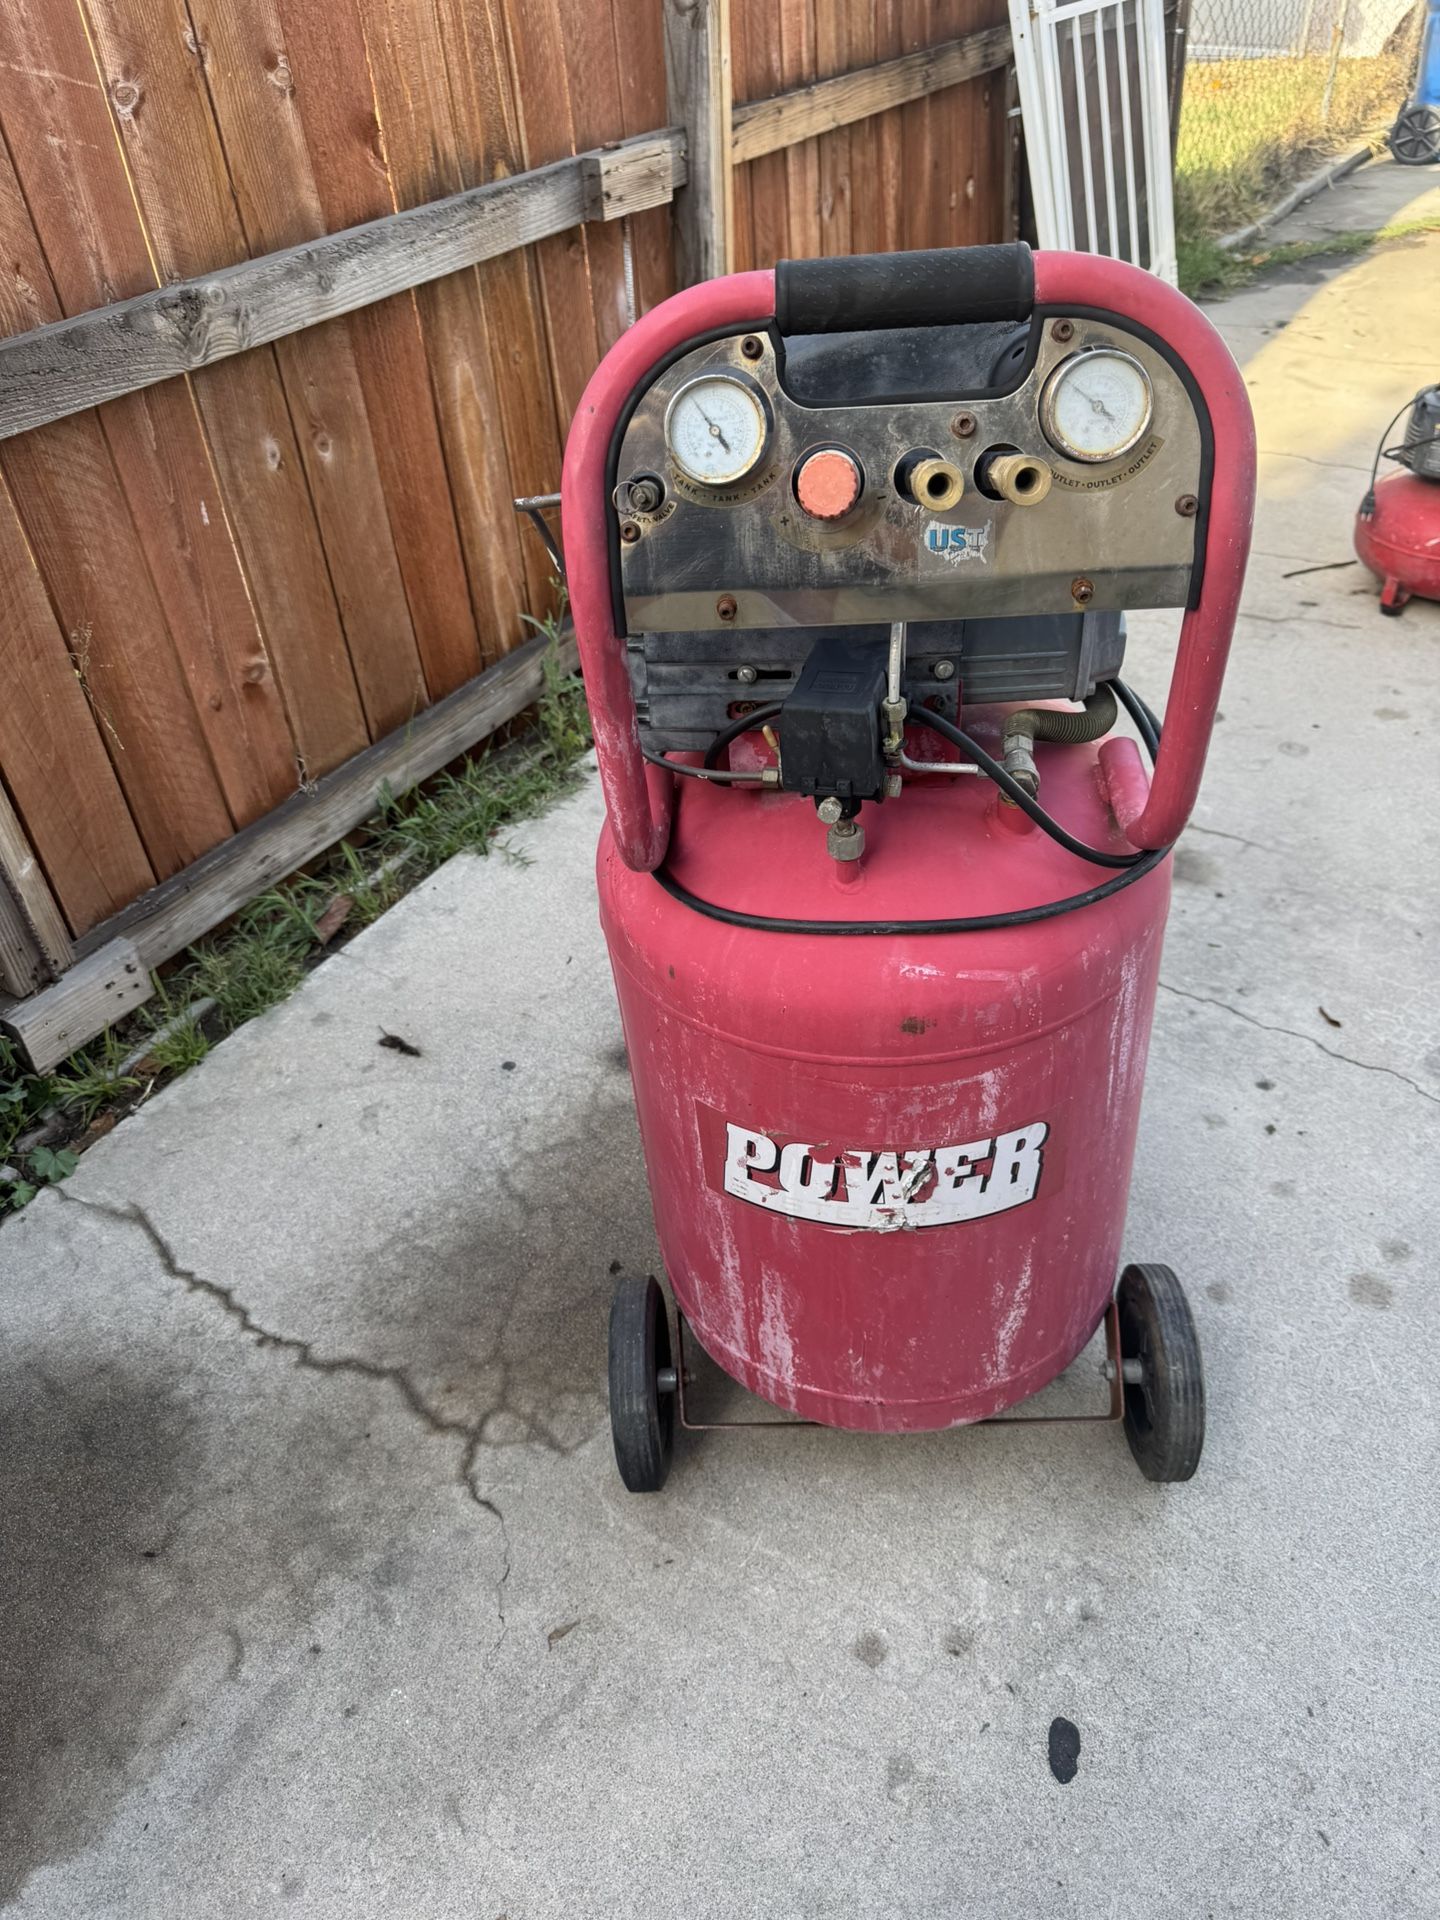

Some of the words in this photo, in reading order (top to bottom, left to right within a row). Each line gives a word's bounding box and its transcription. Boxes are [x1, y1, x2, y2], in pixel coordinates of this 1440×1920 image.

[1087, 473, 1123, 489] OUTLET
[1128, 442, 1158, 474] OUTLET
[673, 473, 698, 496] TANK
[712, 494, 740, 502] TANK
[750, 472, 776, 494] TANK
[652, 502, 675, 522] VALVE
[724, 1121, 1051, 1208] POWER
